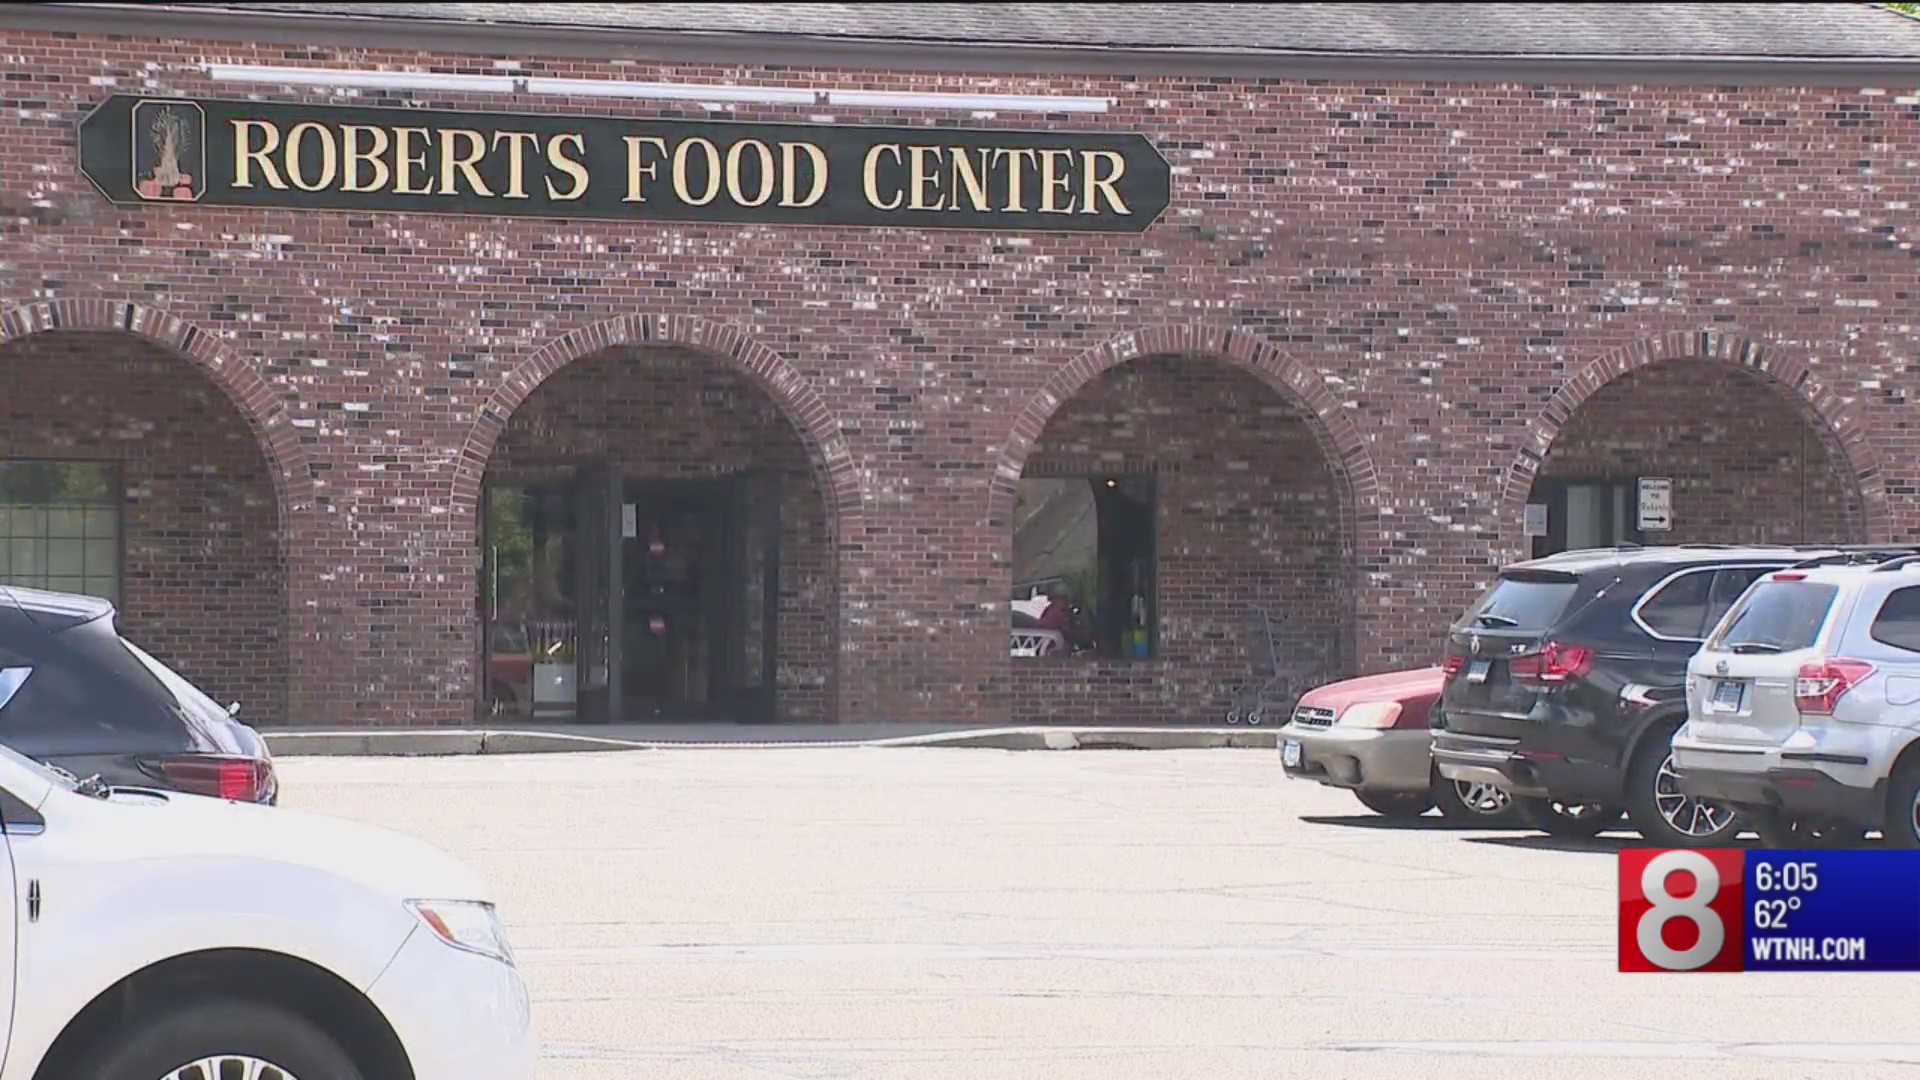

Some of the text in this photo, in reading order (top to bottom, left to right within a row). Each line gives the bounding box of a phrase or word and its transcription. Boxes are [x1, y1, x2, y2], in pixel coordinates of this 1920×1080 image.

[229, 118, 1133, 216] ROBERTS FOOD CENTER
